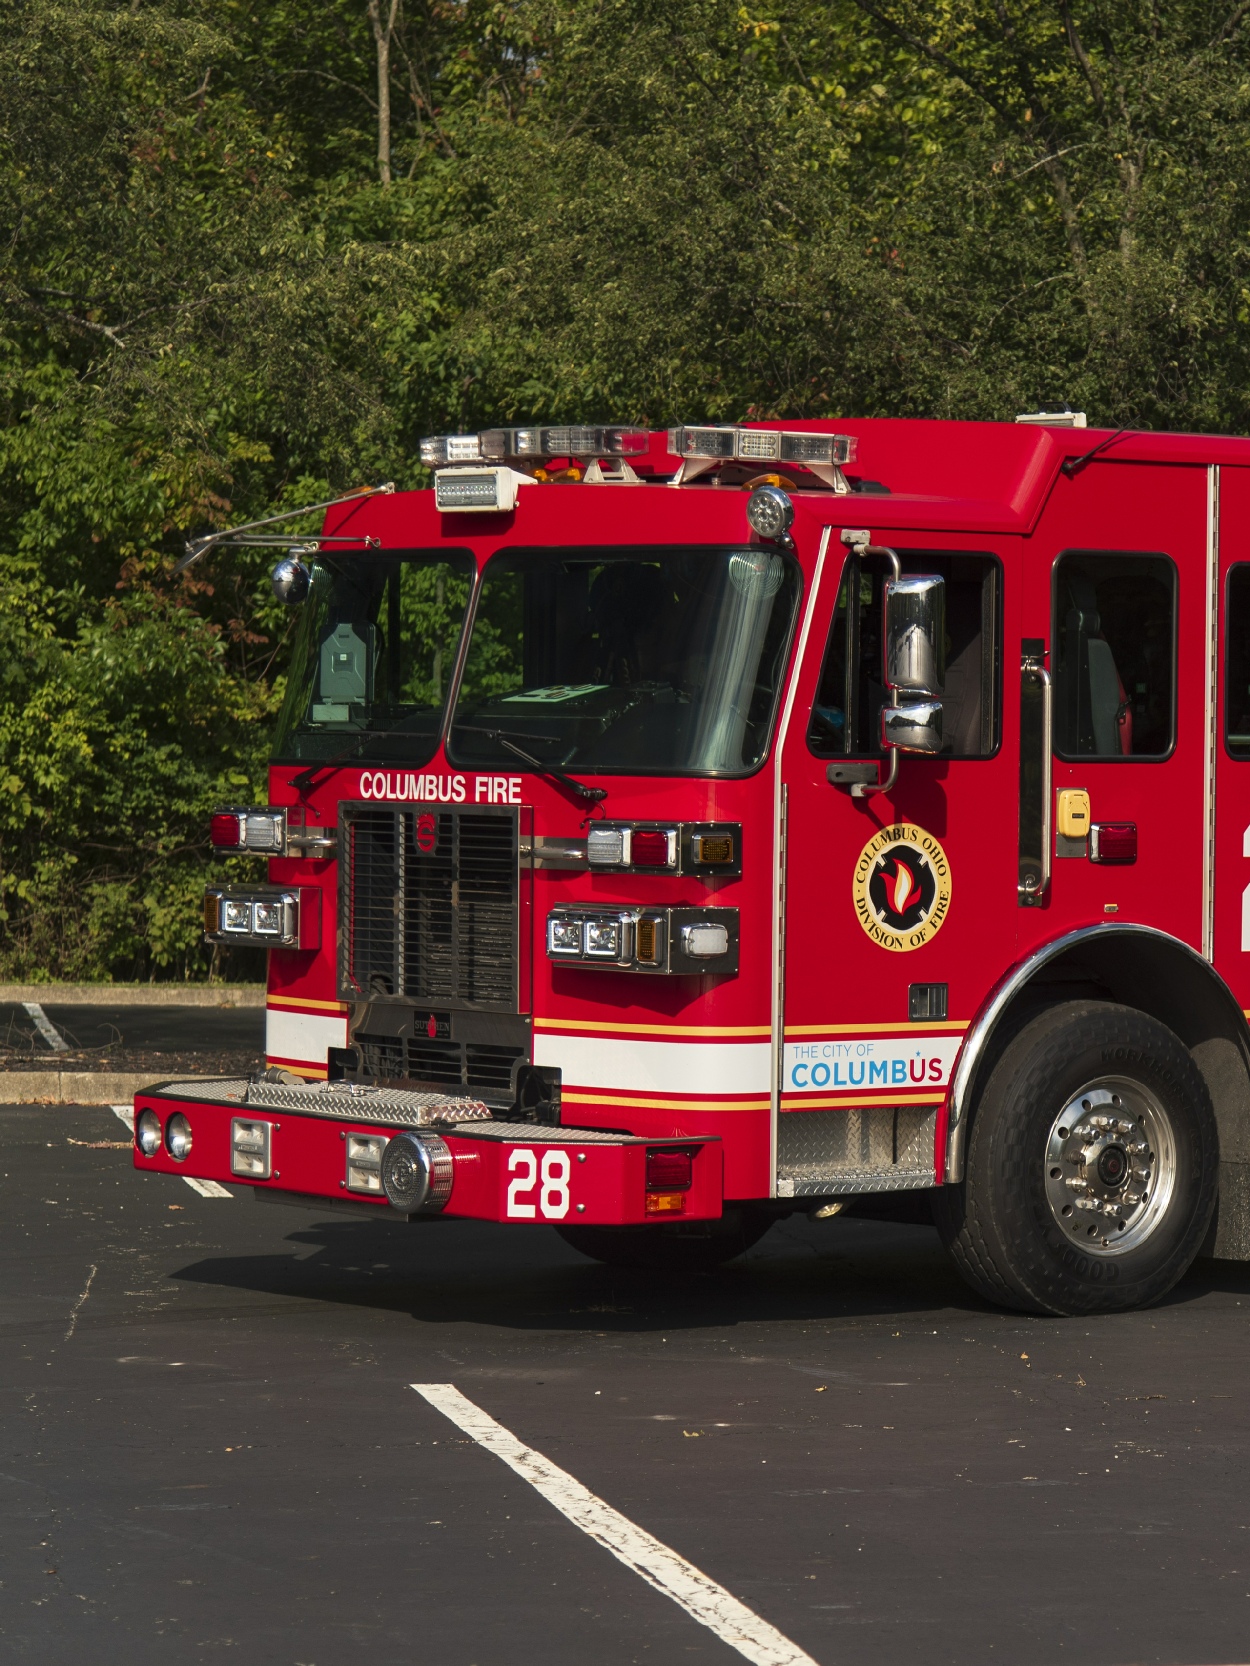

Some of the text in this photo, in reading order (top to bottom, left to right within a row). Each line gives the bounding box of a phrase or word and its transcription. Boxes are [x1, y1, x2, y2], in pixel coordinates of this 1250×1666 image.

[359, 771, 522, 804] COLUMBUS FIRE
[856, 827, 947, 884] COLUMBUS OHIO
[856, 890, 950, 950] DIVISION OF FIRE
[414, 1019, 450, 1032] SUTHEN
[793, 1043, 874, 1059] THE CITY OF
[791, 1057, 943, 1088] COLUMBUS
[506, 1148, 571, 1220] 28
